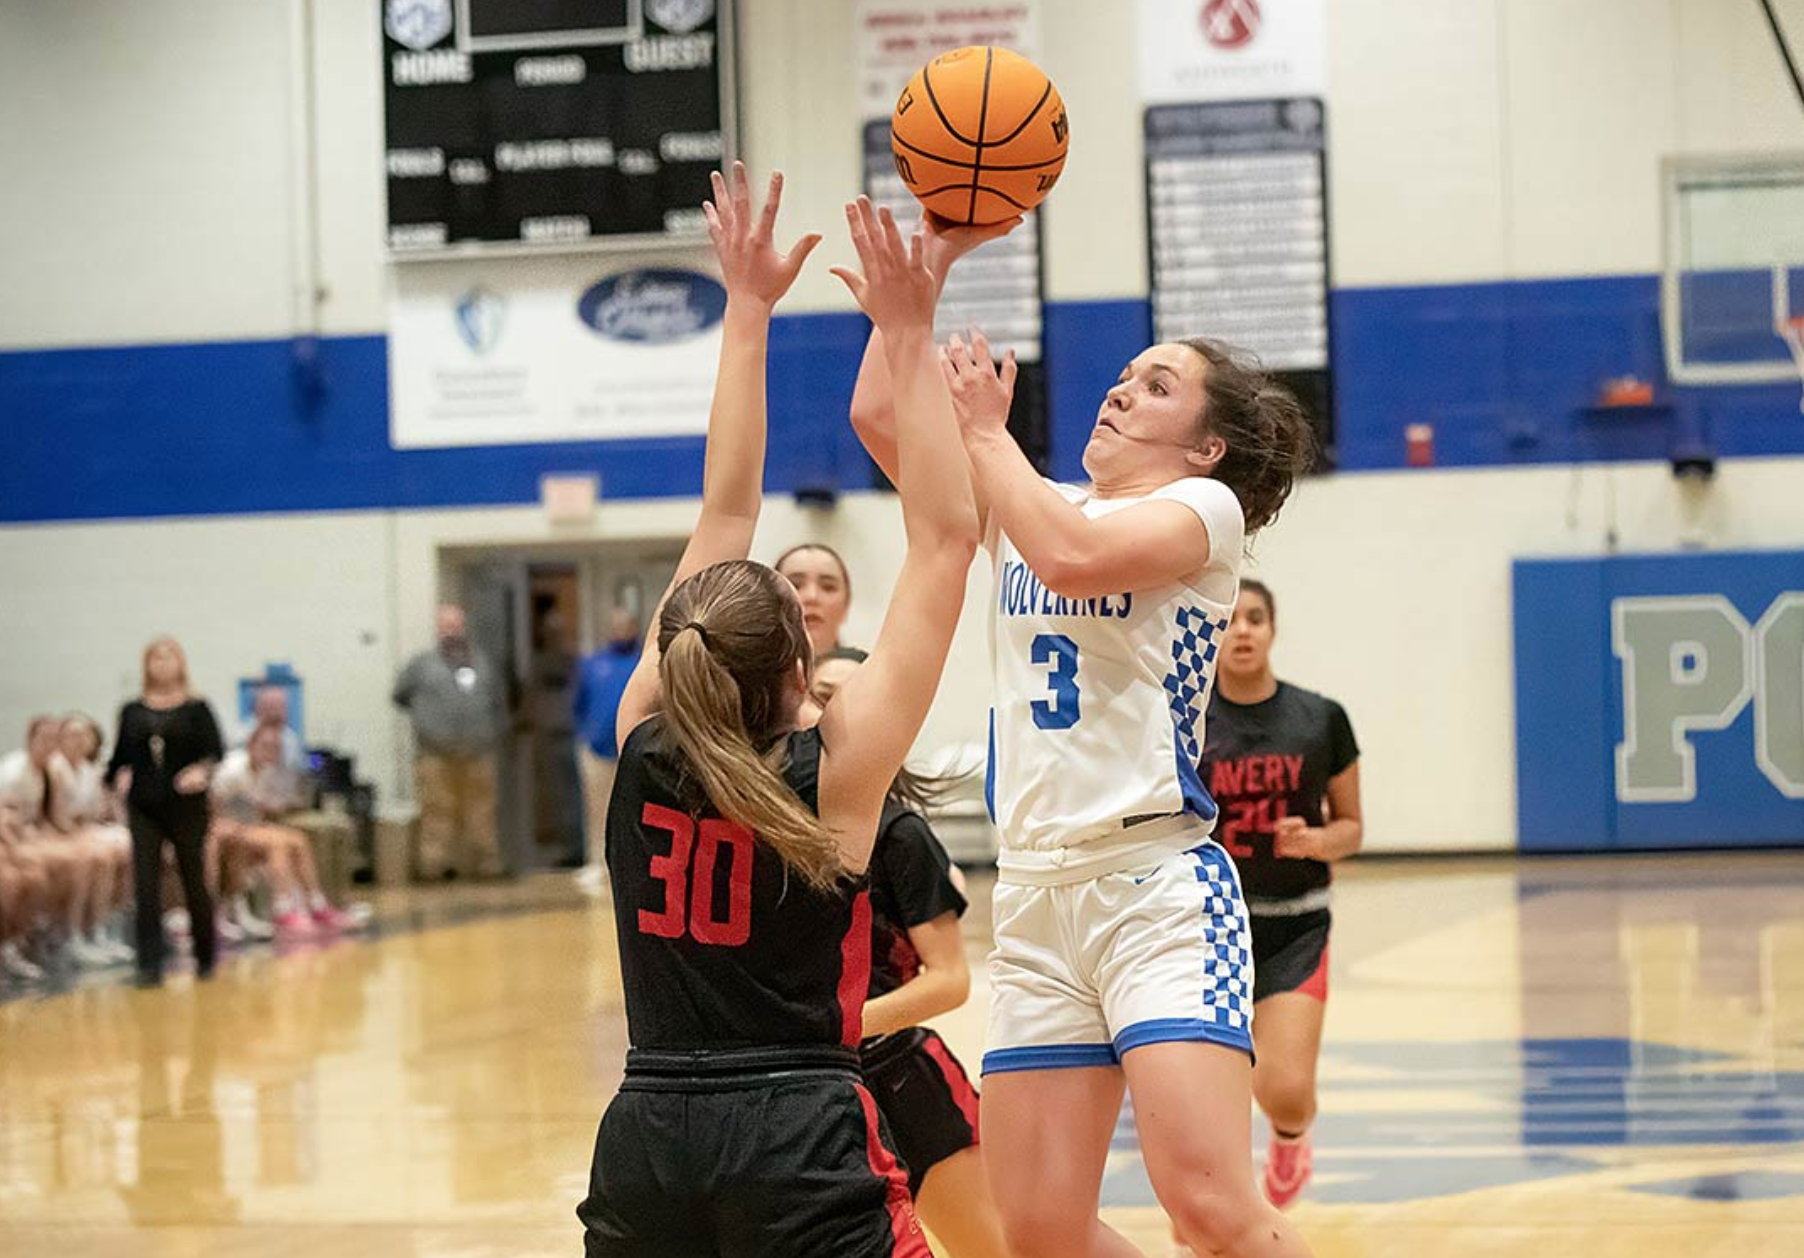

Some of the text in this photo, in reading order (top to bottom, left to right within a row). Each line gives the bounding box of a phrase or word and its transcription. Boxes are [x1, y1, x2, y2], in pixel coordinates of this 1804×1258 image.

[393, 49, 473, 86] HOME
[624, 32, 714, 73] GUEST
[1030, 634, 1081, 730] 3
[1211, 754, 1305, 797] AVERY
[1223, 796, 1288, 860] 24
[638, 801, 754, 946] 30
